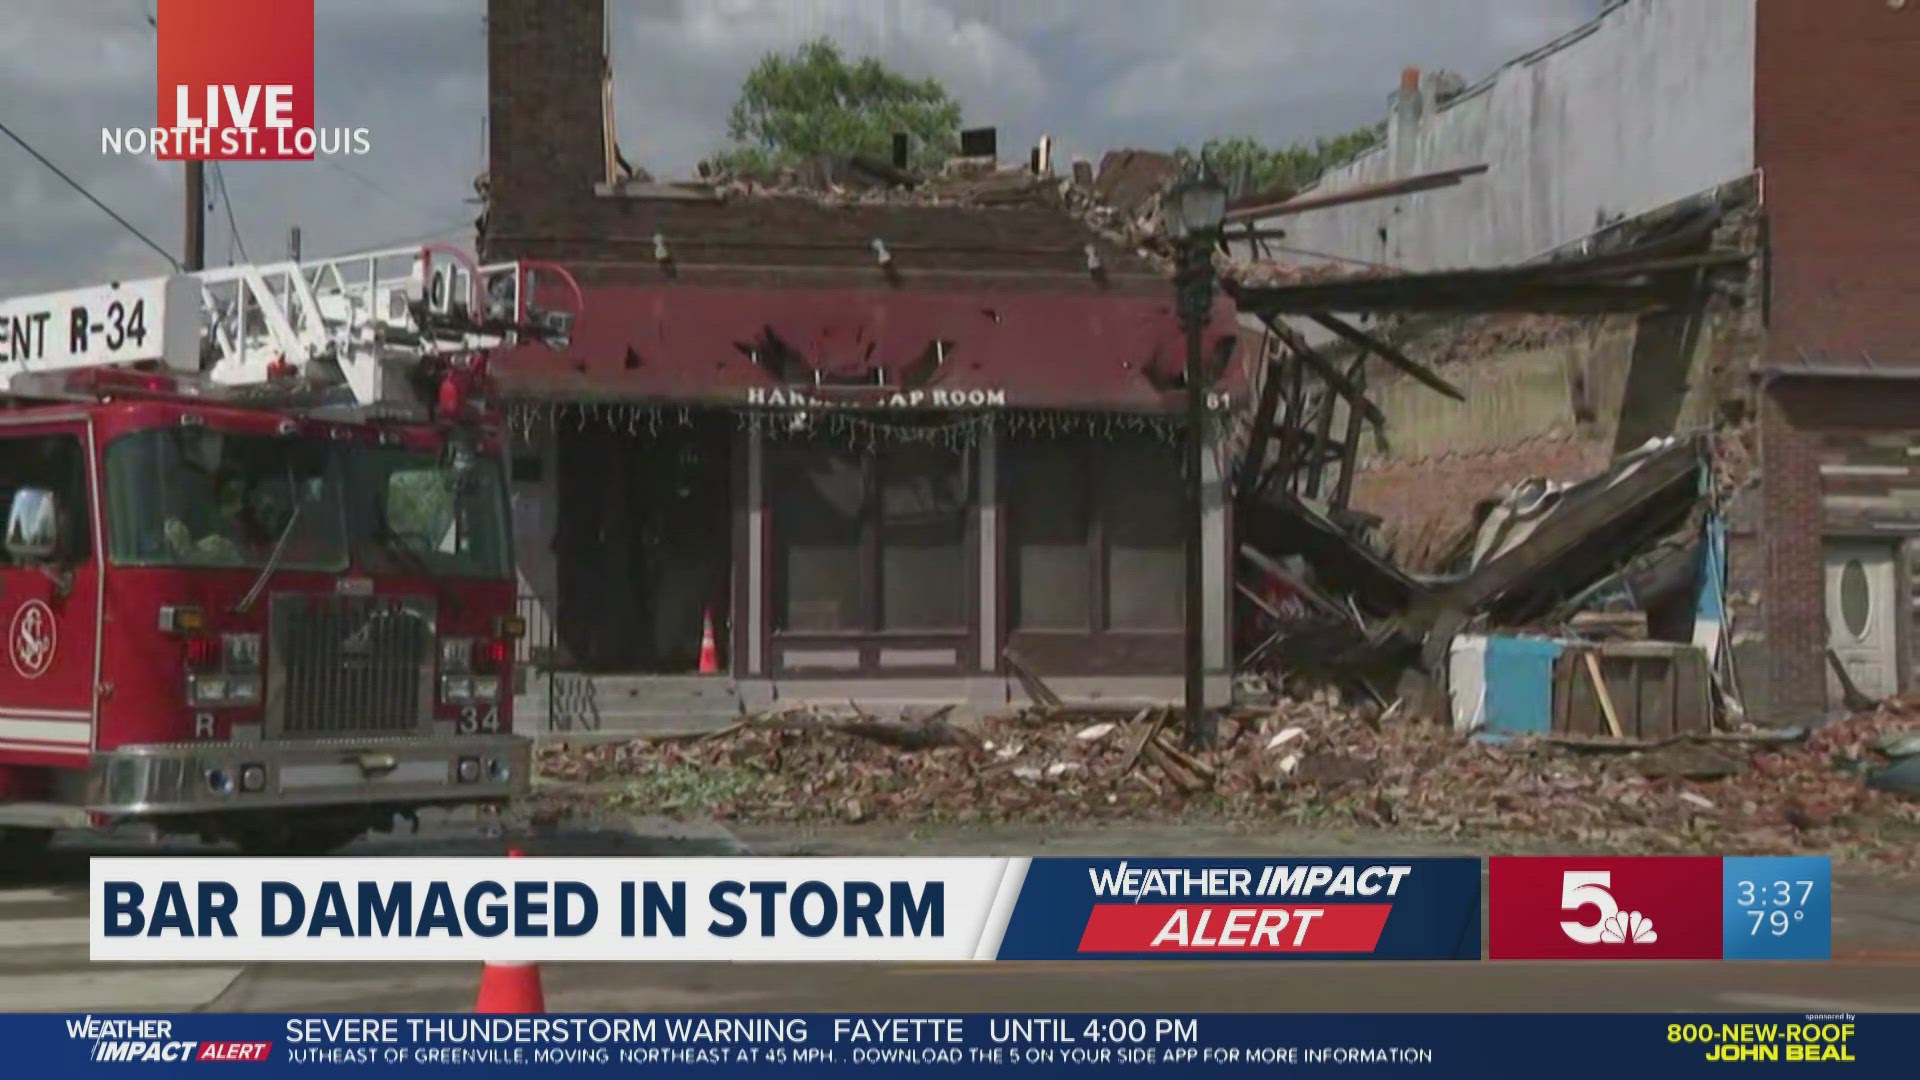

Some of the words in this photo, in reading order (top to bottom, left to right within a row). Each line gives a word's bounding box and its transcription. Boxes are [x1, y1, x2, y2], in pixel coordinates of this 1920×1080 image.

[69, 298, 146, 354] R-34
[933, 389, 1005, 406] ROOM
[195, 712, 214, 738] R
[459, 706, 499, 734] 34
